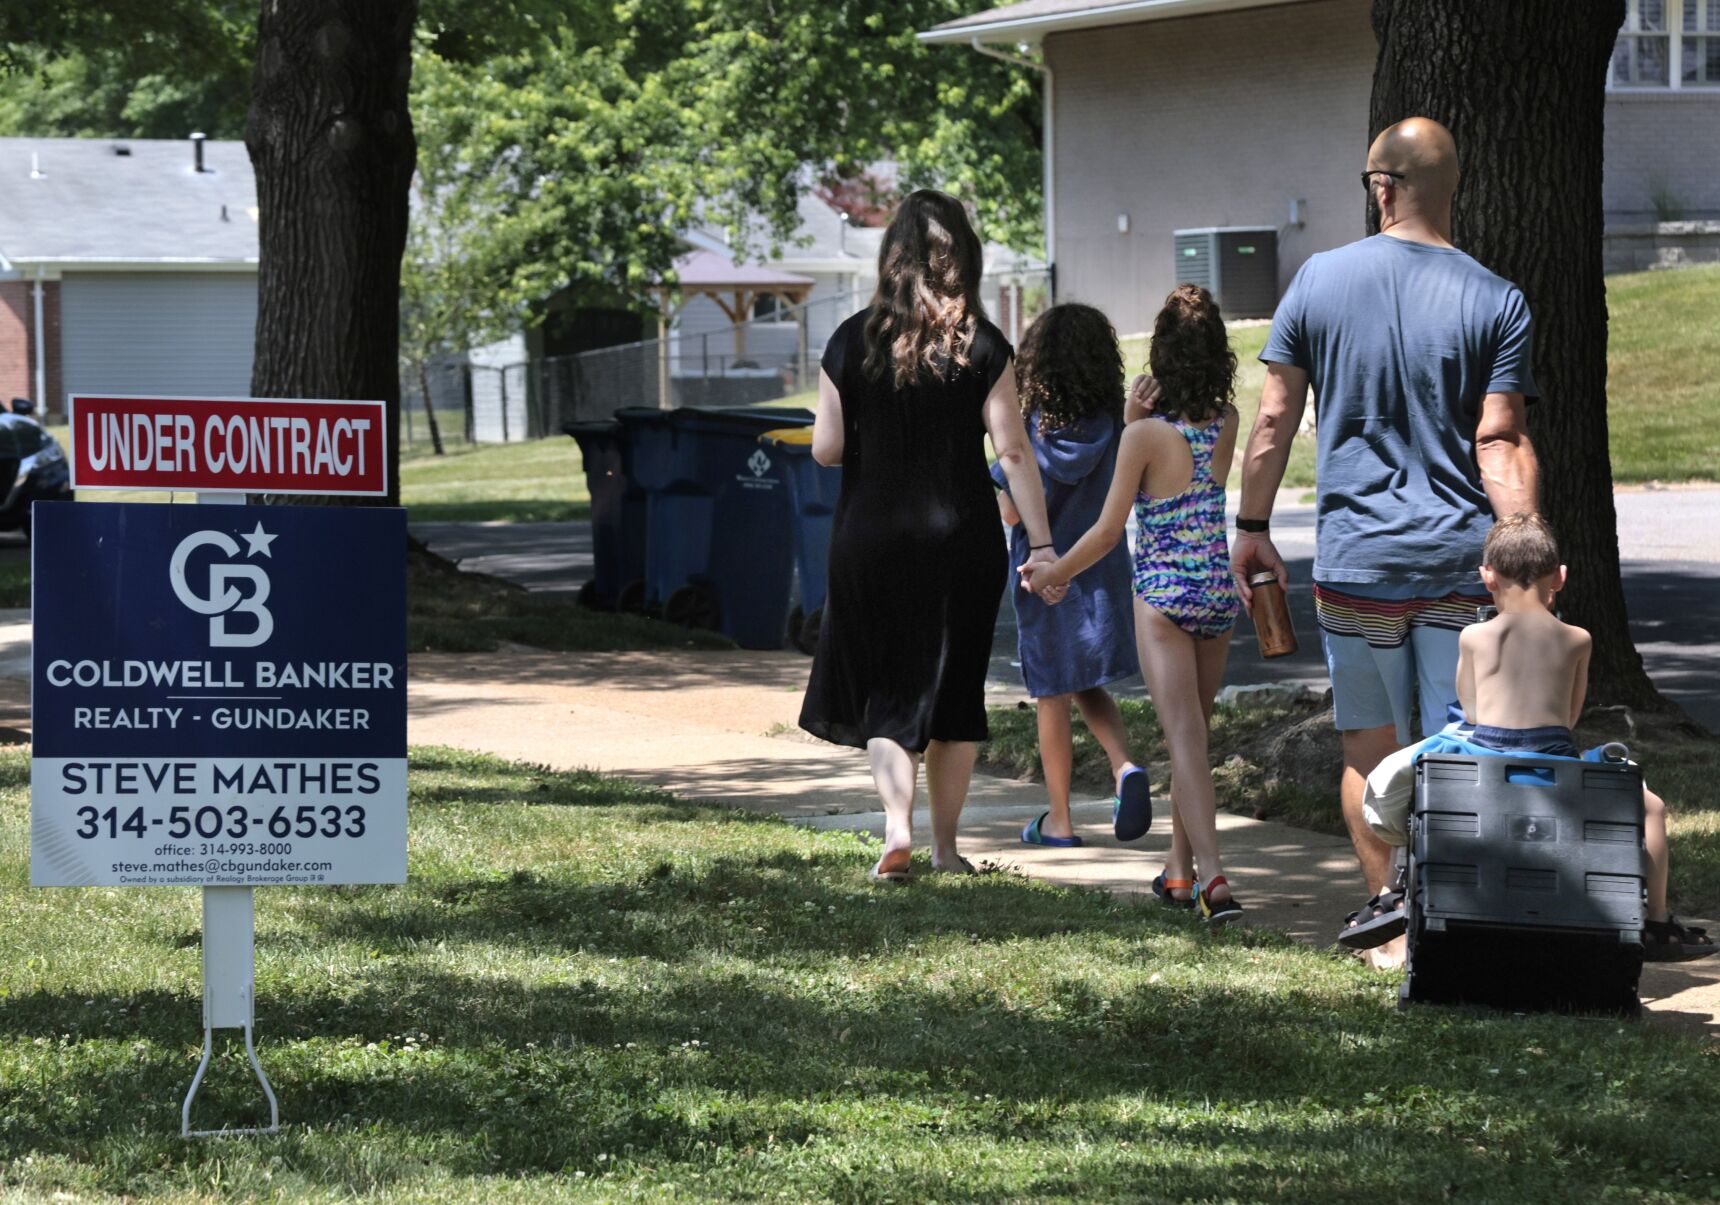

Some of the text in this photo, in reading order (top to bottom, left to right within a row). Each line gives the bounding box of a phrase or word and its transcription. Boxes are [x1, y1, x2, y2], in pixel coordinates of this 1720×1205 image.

[87, 412, 371, 476] UNDER CONTRACT
[46, 659, 394, 689] COLDWELL BANKER
[74, 707, 183, 729] REALTY
[211, 707, 370, 730] GUNDAKER
[62, 762, 381, 795] STEVE MATHES
[76, 804, 366, 840] 314-503-6533
[154, 843, 292, 856] office: 314-993-8000
[111, 858, 332, 875] steve.mathes@cbgundaker.com
[119, 875, 147, 883] Owned
[166, 875, 204, 884] subsidiary
[285, 874, 309, 882] Group
